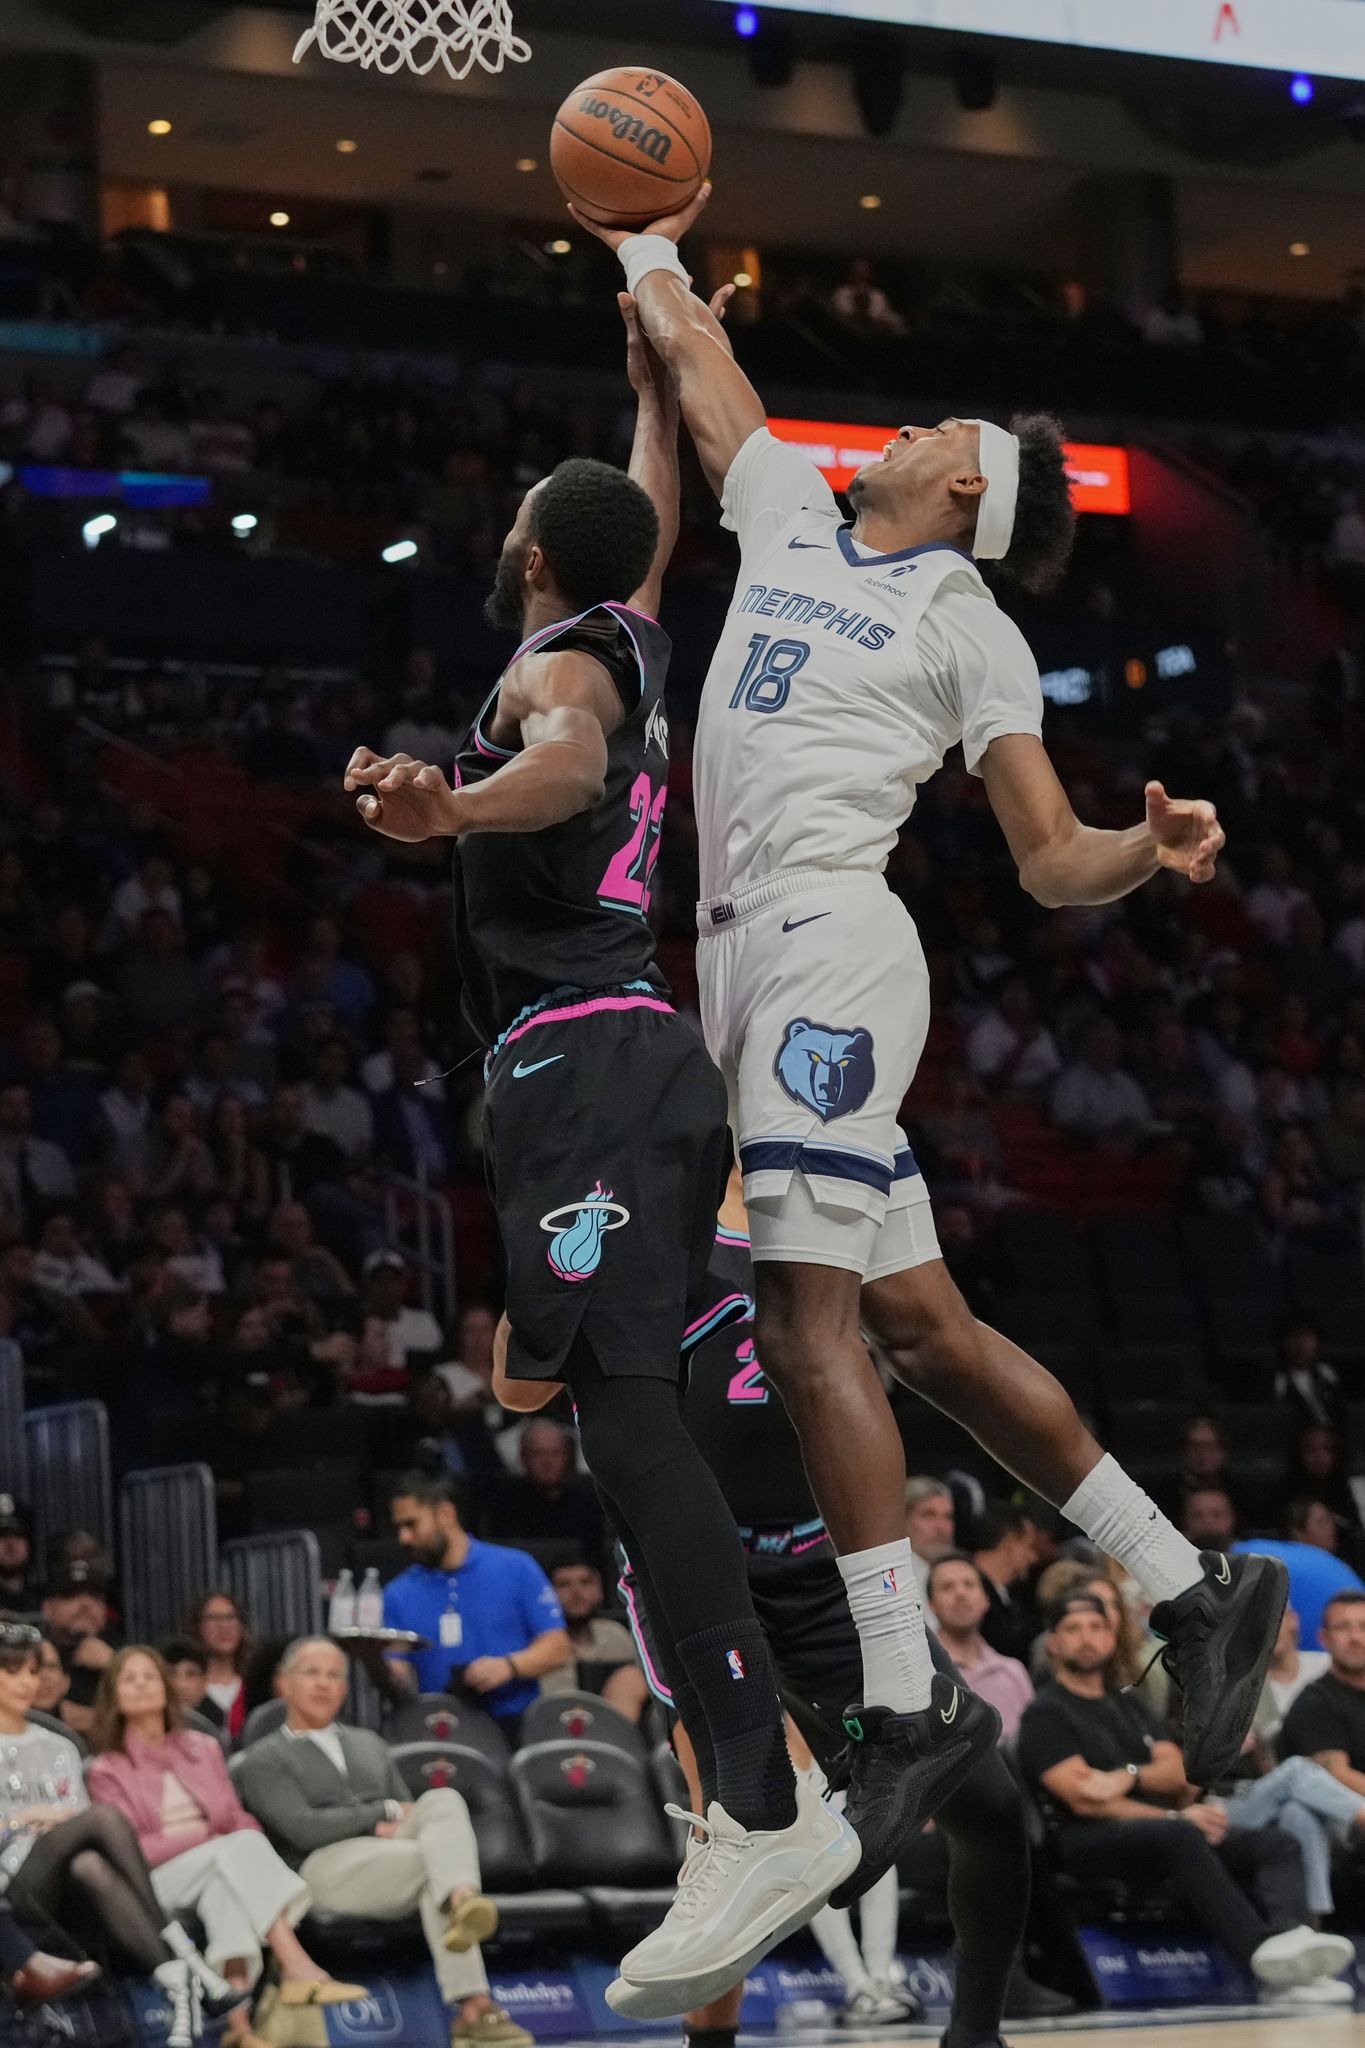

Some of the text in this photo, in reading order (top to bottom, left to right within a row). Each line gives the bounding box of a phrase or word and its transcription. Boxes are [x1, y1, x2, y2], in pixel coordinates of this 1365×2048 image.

[578, 96, 672, 165] Wilson
[736, 584, 896, 651] MEMPHIS
[864, 577, 907, 598] Robinhood
[728, 633, 811, 714] 18
